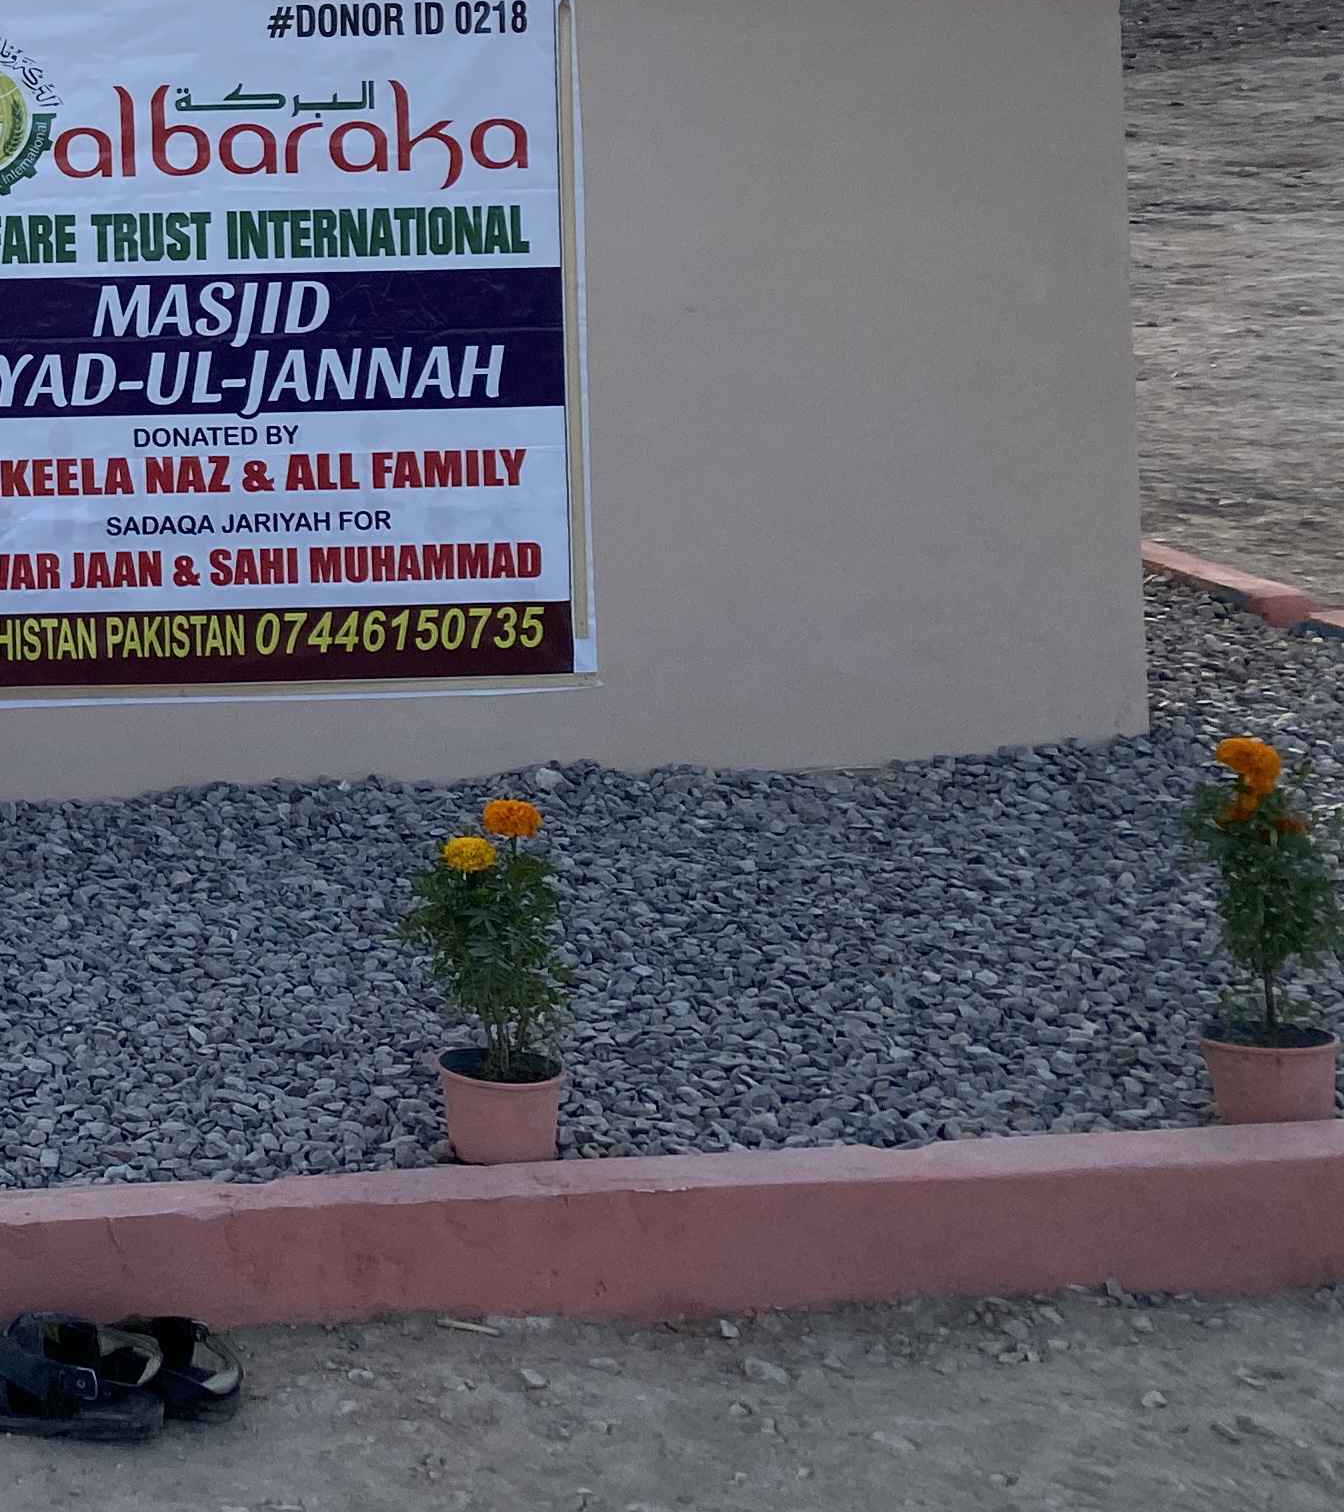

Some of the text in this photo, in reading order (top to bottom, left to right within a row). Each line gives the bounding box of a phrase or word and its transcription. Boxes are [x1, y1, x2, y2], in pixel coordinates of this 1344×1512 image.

[267, 0, 528, 39] #DONOR ID 0218
[175, 80, 375, 119] البركة
[3, 122, 48, 182] International
[52, 80, 529, 190] albaraka
[91, 211, 212, 262] TRUST
[226, 205, 531, 259] INTERNATIONAL
[92, 281, 330, 347] MASJID
[133, 425, 299, 447] DONATED BY
[145, 455, 231, 494] NAZ
[242, 460, 275, 493] &
[285, 453, 360, 491] ALL
[371, 448, 527, 489] FAMILY
[106, 510, 391, 536] SADAQA JARIYAH FOR
[70, 550, 162, 589] JAAN
[172, 555, 201, 587] &
[209, 547, 299, 586] SAHI
[309, 541, 542, 583] MUHAMMAD
[105, 614, 245, 658] PAKISTAN
[255, 606, 545, 655] 07446150735
